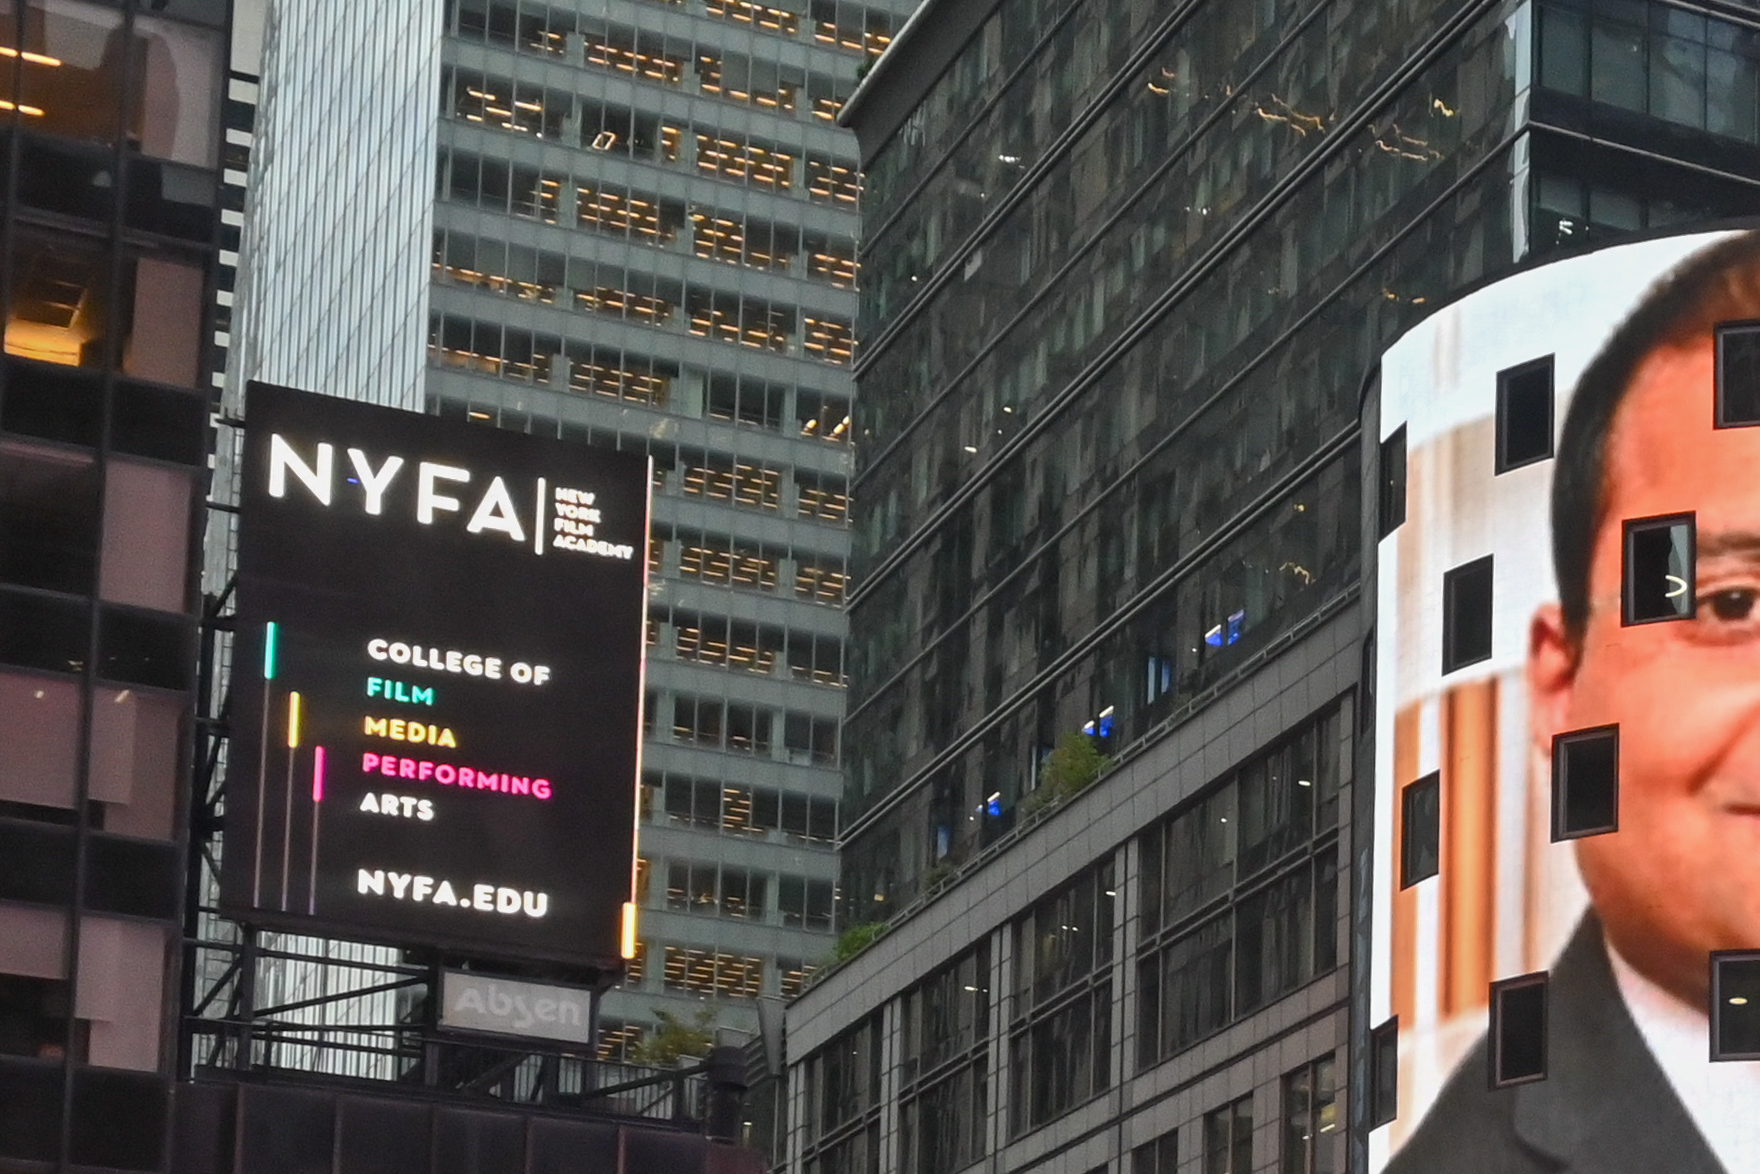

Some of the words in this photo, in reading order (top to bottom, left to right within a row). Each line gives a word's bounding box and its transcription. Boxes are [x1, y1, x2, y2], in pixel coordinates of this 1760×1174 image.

[268, 433, 526, 543] NYFA
[555, 487, 595, 506] NEW
[554, 517, 594, 537] FILM
[555, 502, 601, 524] YORK
[553, 534, 634, 560] ACADEMY
[367, 638, 503, 680] COLLEGE
[510, 662, 550, 686] OF
[366, 676, 434, 706] FILM
[364, 715, 457, 749] MEDIA
[362, 752, 553, 800] PERFORMING
[359, 792, 435, 821] ARTS
[357, 868, 549, 918] NYFA.EDU
[455, 983, 581, 1030] Absen
